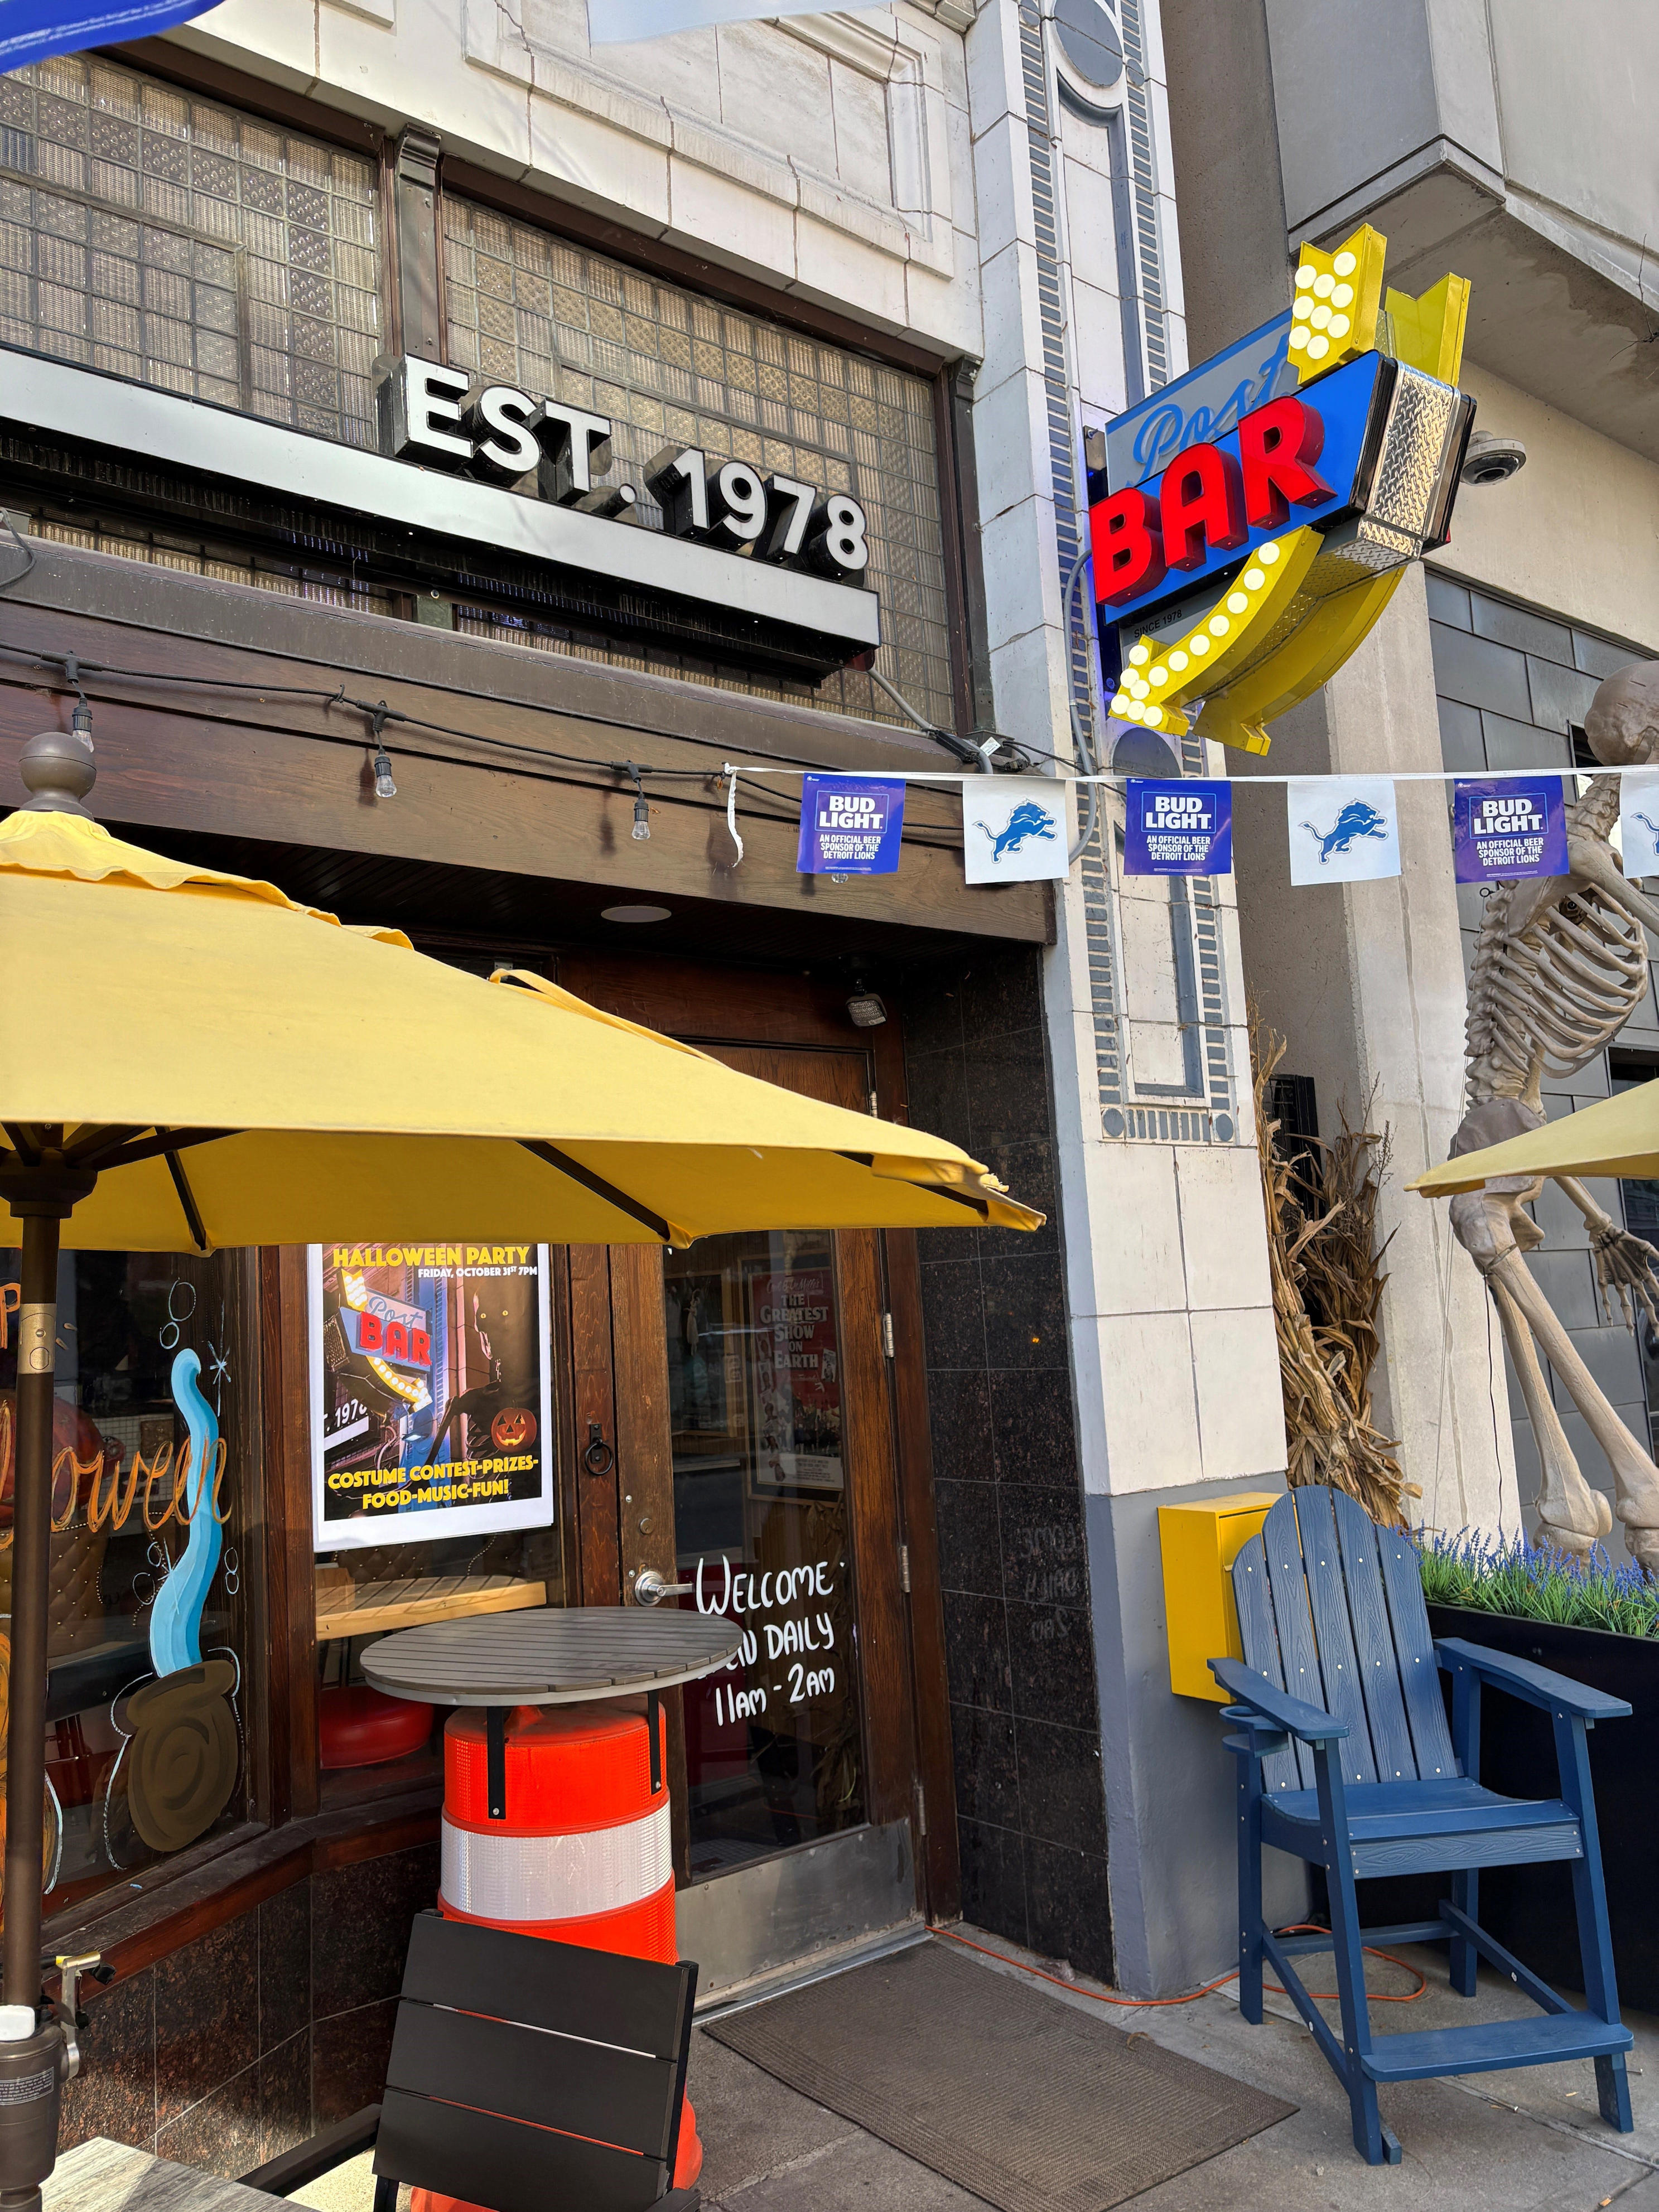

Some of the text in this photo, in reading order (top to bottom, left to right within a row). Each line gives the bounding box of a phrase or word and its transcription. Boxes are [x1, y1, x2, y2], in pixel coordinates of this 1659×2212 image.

[1126, 335, 1295, 488] Post
[406, 355, 868, 571] EST. 1978
[1089, 397, 1337, 606] BAR
[1134, 610, 1182, 638] SINCE 1978
[829, 795, 875, 813] BUD
[1155, 796, 1203, 813] BUD
[1482, 799, 1532, 817] BUD
[821, 843, 853, 851] SPONSOR
[831, 834, 862, 843] OFFICIAL
[1146, 835, 1157, 843] AN
[1159, 835, 1190, 844] OFFICIAL
[1477, 838, 1544, 850] AN OFFICIAL BEER
[1148, 844, 1182, 852] SPONSOR
[1479, 848, 1515, 858] SPONSOR
[1528, 846, 1542, 854] THE
[1483, 854, 1540, 866] DETROIT LIONS
[333, 1246, 530, 1267] HALLOWEEN PARTY
[418, 1268, 454, 1278] FRIDAY,
[456, 1267, 501, 1277] OCTOBER
[518, 1267, 537, 1276] 7PM
[781, 1293, 804, 1306] THE
[369, 1296, 423, 1330] Post
[760, 1305, 828, 1324] GREATEST
[359, 1311, 432, 1366] BAR
[774, 1323, 814, 1342] SHOW
[788, 1341, 803, 1352] ON
[774, 1350, 818, 1369] EARTH
[327, 1455, 539, 1490] COSTUME CONTEST-PRIZES-
[362, 1479, 509, 1509] FOOD-MUSIC-FUN!
[763, 1612, 836, 1660] DAILY
